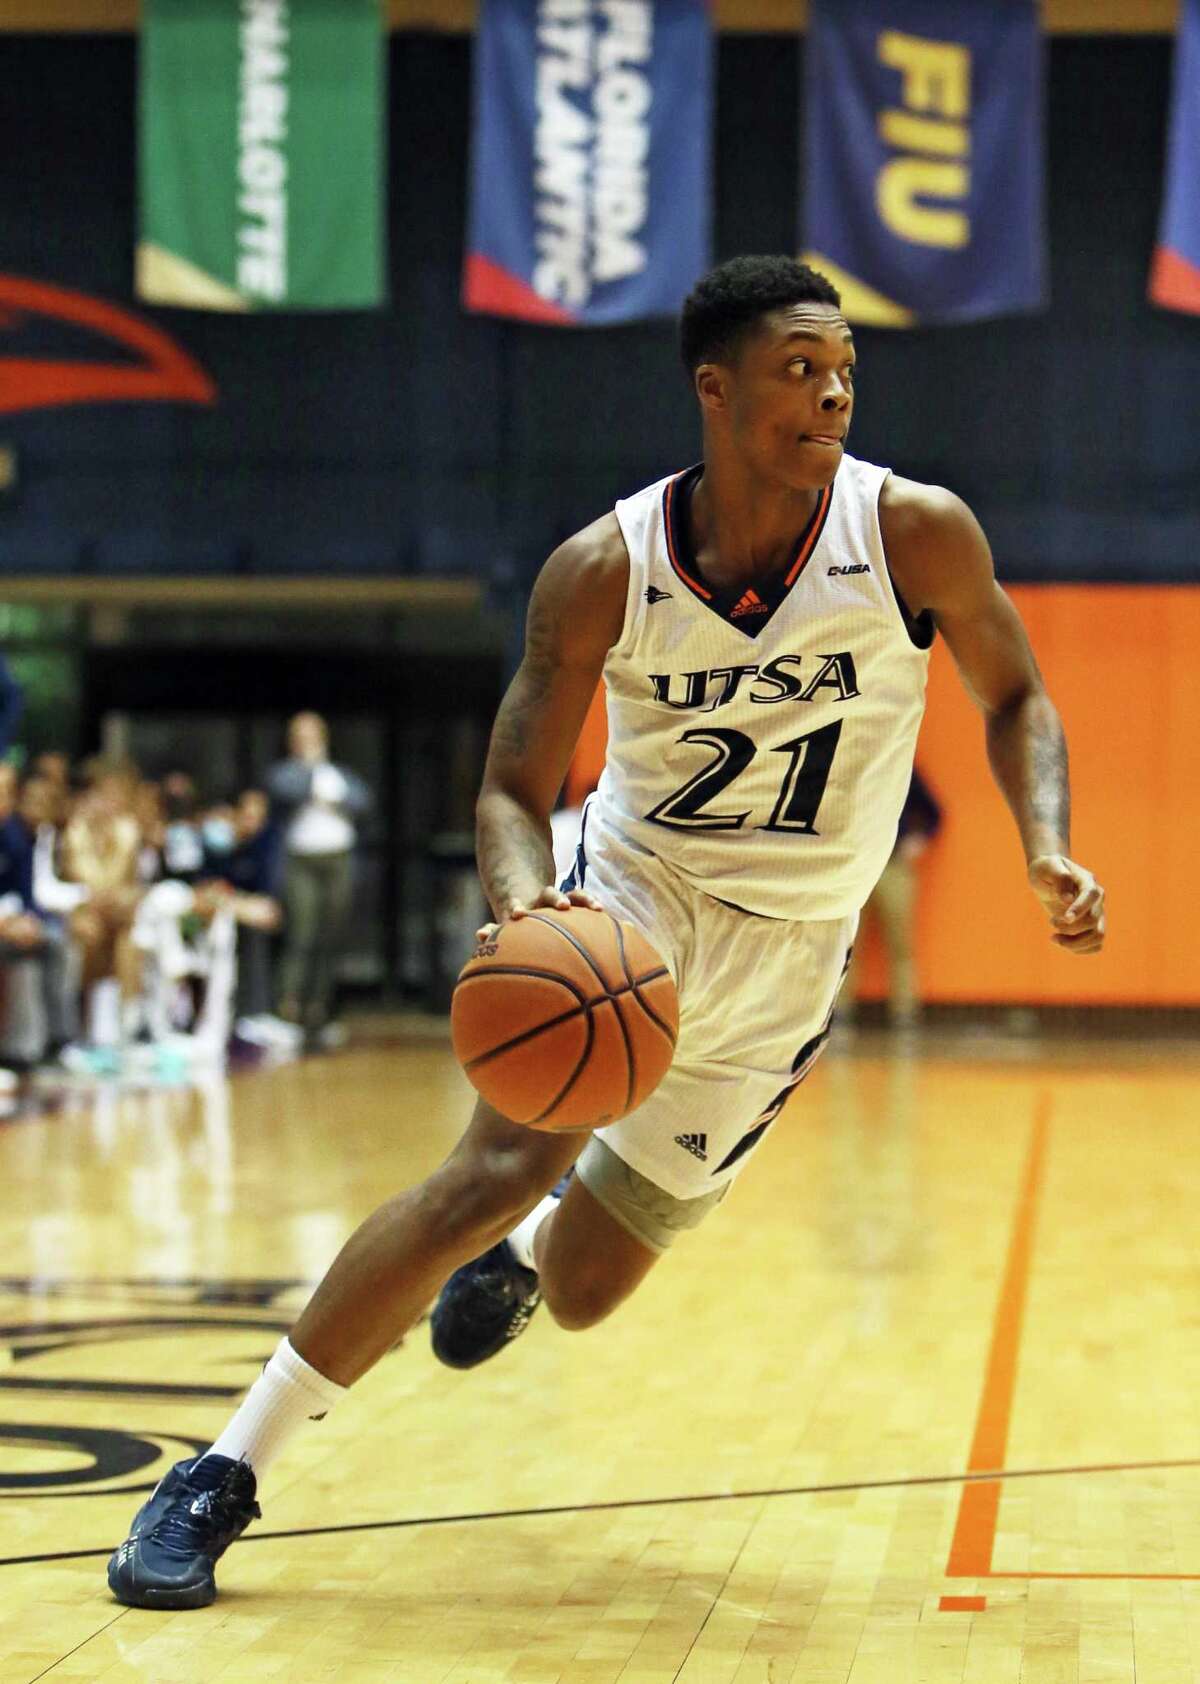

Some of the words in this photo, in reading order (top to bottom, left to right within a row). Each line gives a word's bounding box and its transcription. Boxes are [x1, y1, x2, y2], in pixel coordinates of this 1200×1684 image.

[593, 0, 653, 281] FLORIDA
[876, 28, 971, 250] FIU
[647, 651, 862, 713] UTSA
[643, 717, 844, 836] 21
